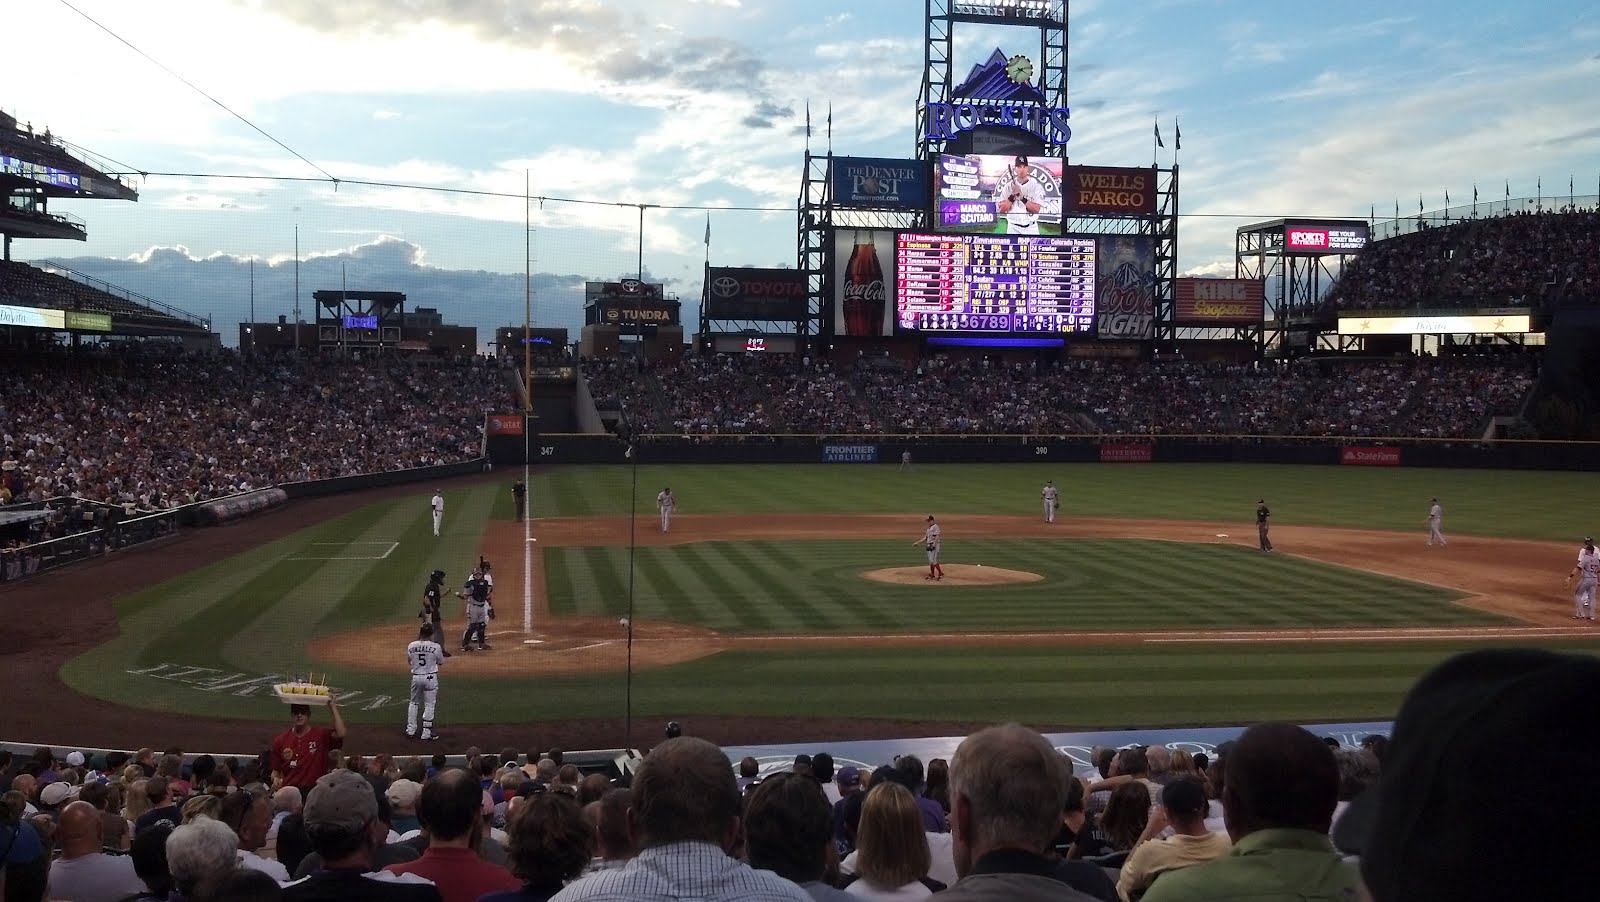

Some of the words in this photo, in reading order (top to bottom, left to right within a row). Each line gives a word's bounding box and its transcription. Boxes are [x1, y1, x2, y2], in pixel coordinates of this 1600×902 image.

[925, 101, 1071, 144] ROCKIES
[847, 166, 865, 178] THE
[865, 165, 914, 180] DENVER
[853, 175, 901, 194] POST
[1078, 174, 1144, 190] WELLS
[1078, 190, 1144, 207] FARGO
[960, 204, 986, 213] MARCO
[960, 213, 994, 223] SCUTARO
[1291, 232, 1325, 240] SPORTS
[742, 281, 804, 296] TOYOTA
[844, 280, 885, 300] Coca-Cola
[1098, 273, 1153, 314] Coors
[1194, 282, 1246, 300] KING
[622, 310, 670, 320] TUNDRA
[1192, 300, 1248, 318] Soopers
[1056, 315, 1075, 324] 0-0
[1098, 314, 1154, 336] LIGHT
[503, 420, 521, 429] at&t
[541, 446, 554, 456] 347
[1036, 446, 1048, 455] 390
[418, 654, 426, 666] 5
